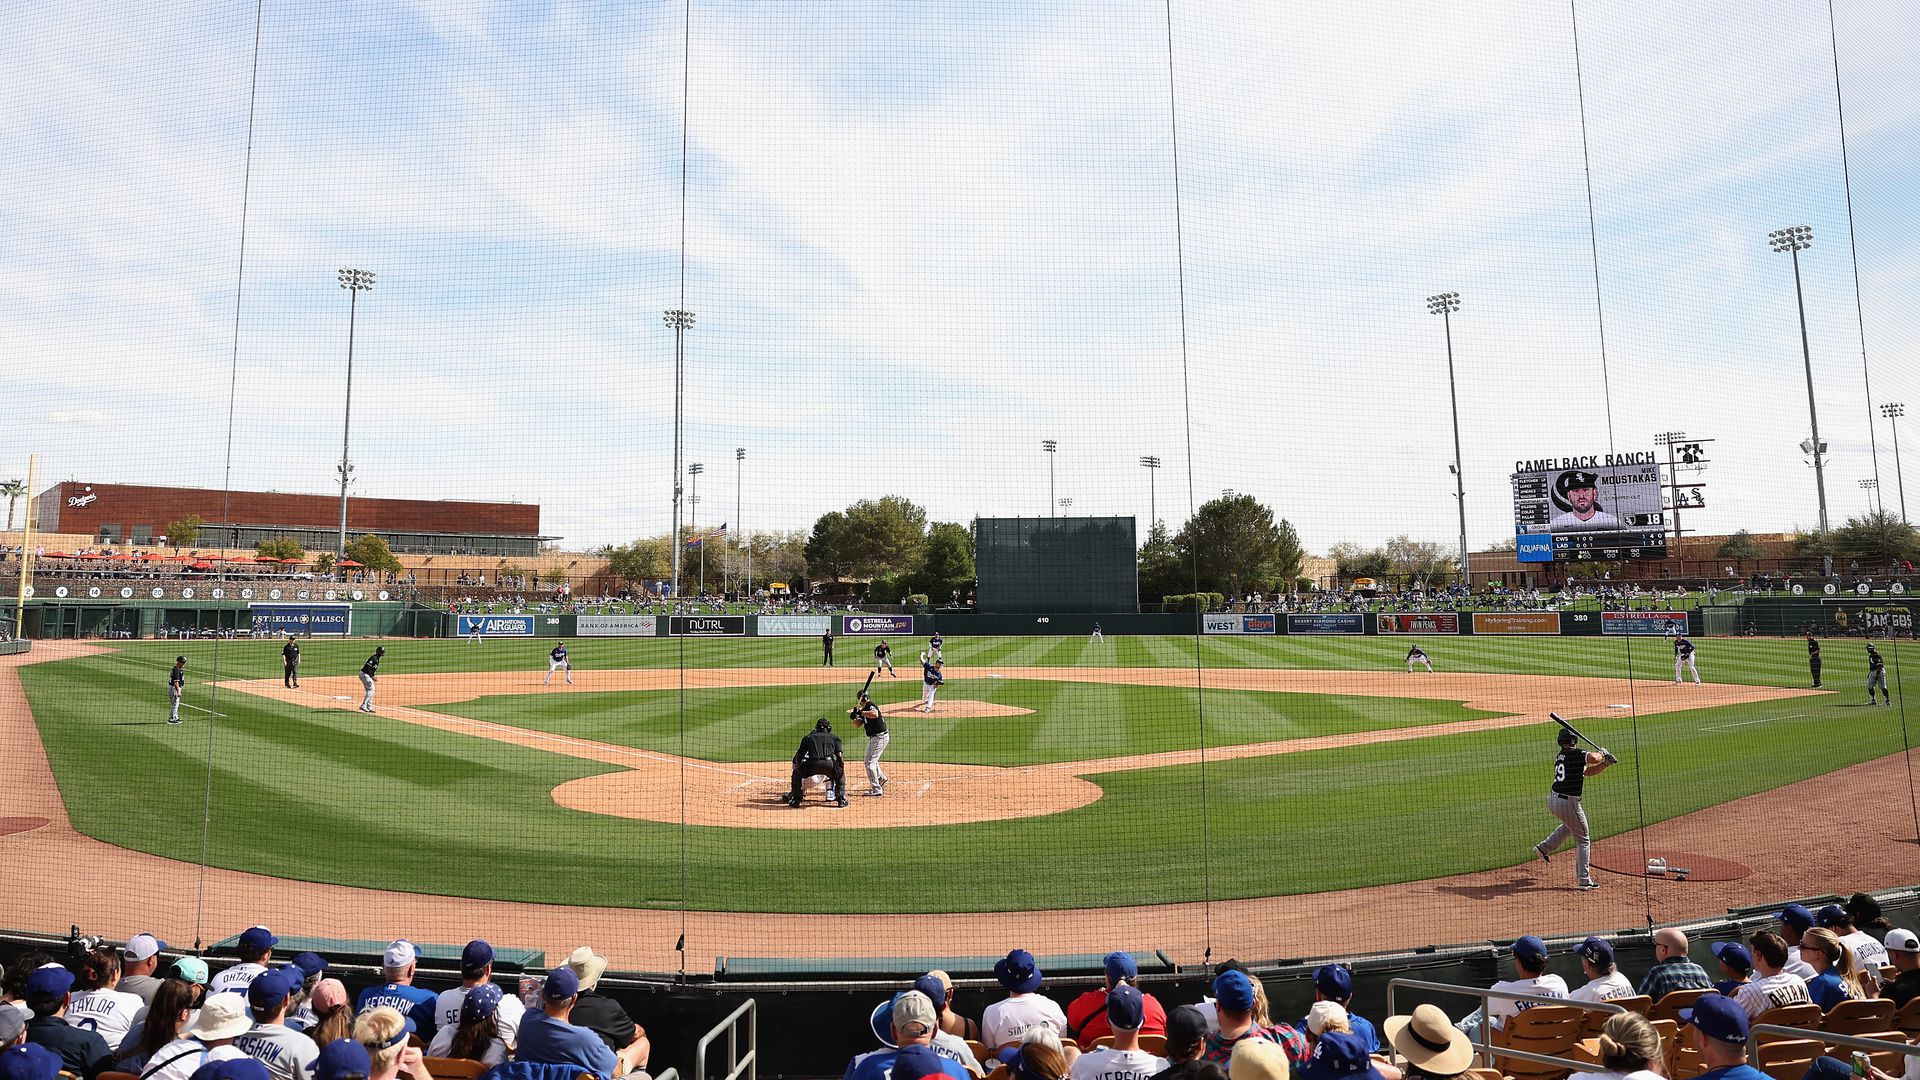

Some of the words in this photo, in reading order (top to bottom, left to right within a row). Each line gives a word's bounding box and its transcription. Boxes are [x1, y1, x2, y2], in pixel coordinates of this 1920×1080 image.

[1515, 455, 1598, 473] CAMELBACK
[1605, 451, 1656, 467] RANCH
[1601, 474, 1657, 485] MOUSTAKAS
[68, 493, 97, 507] Dodgers
[1647, 513, 1661, 525] 18
[1519, 544, 1551, 553] AQUAFINA
[1248, 618, 1273, 629] plays
[1573, 614, 1588, 622] 380
[486, 619, 505, 631] AIR
[1207, 622, 1235, 630] WEST
[1410, 620, 1422, 629] TWIN
[1422, 620, 1437, 629] PEAKS
[223, 972, 255, 984] OHTAN
[1768, 984, 1810, 1008] OHTANI
[70, 996, 116, 1015] TAYLOR
[365, 996, 415, 1016] KERSHAW
[231, 1036, 284, 1063] ERSHAW
